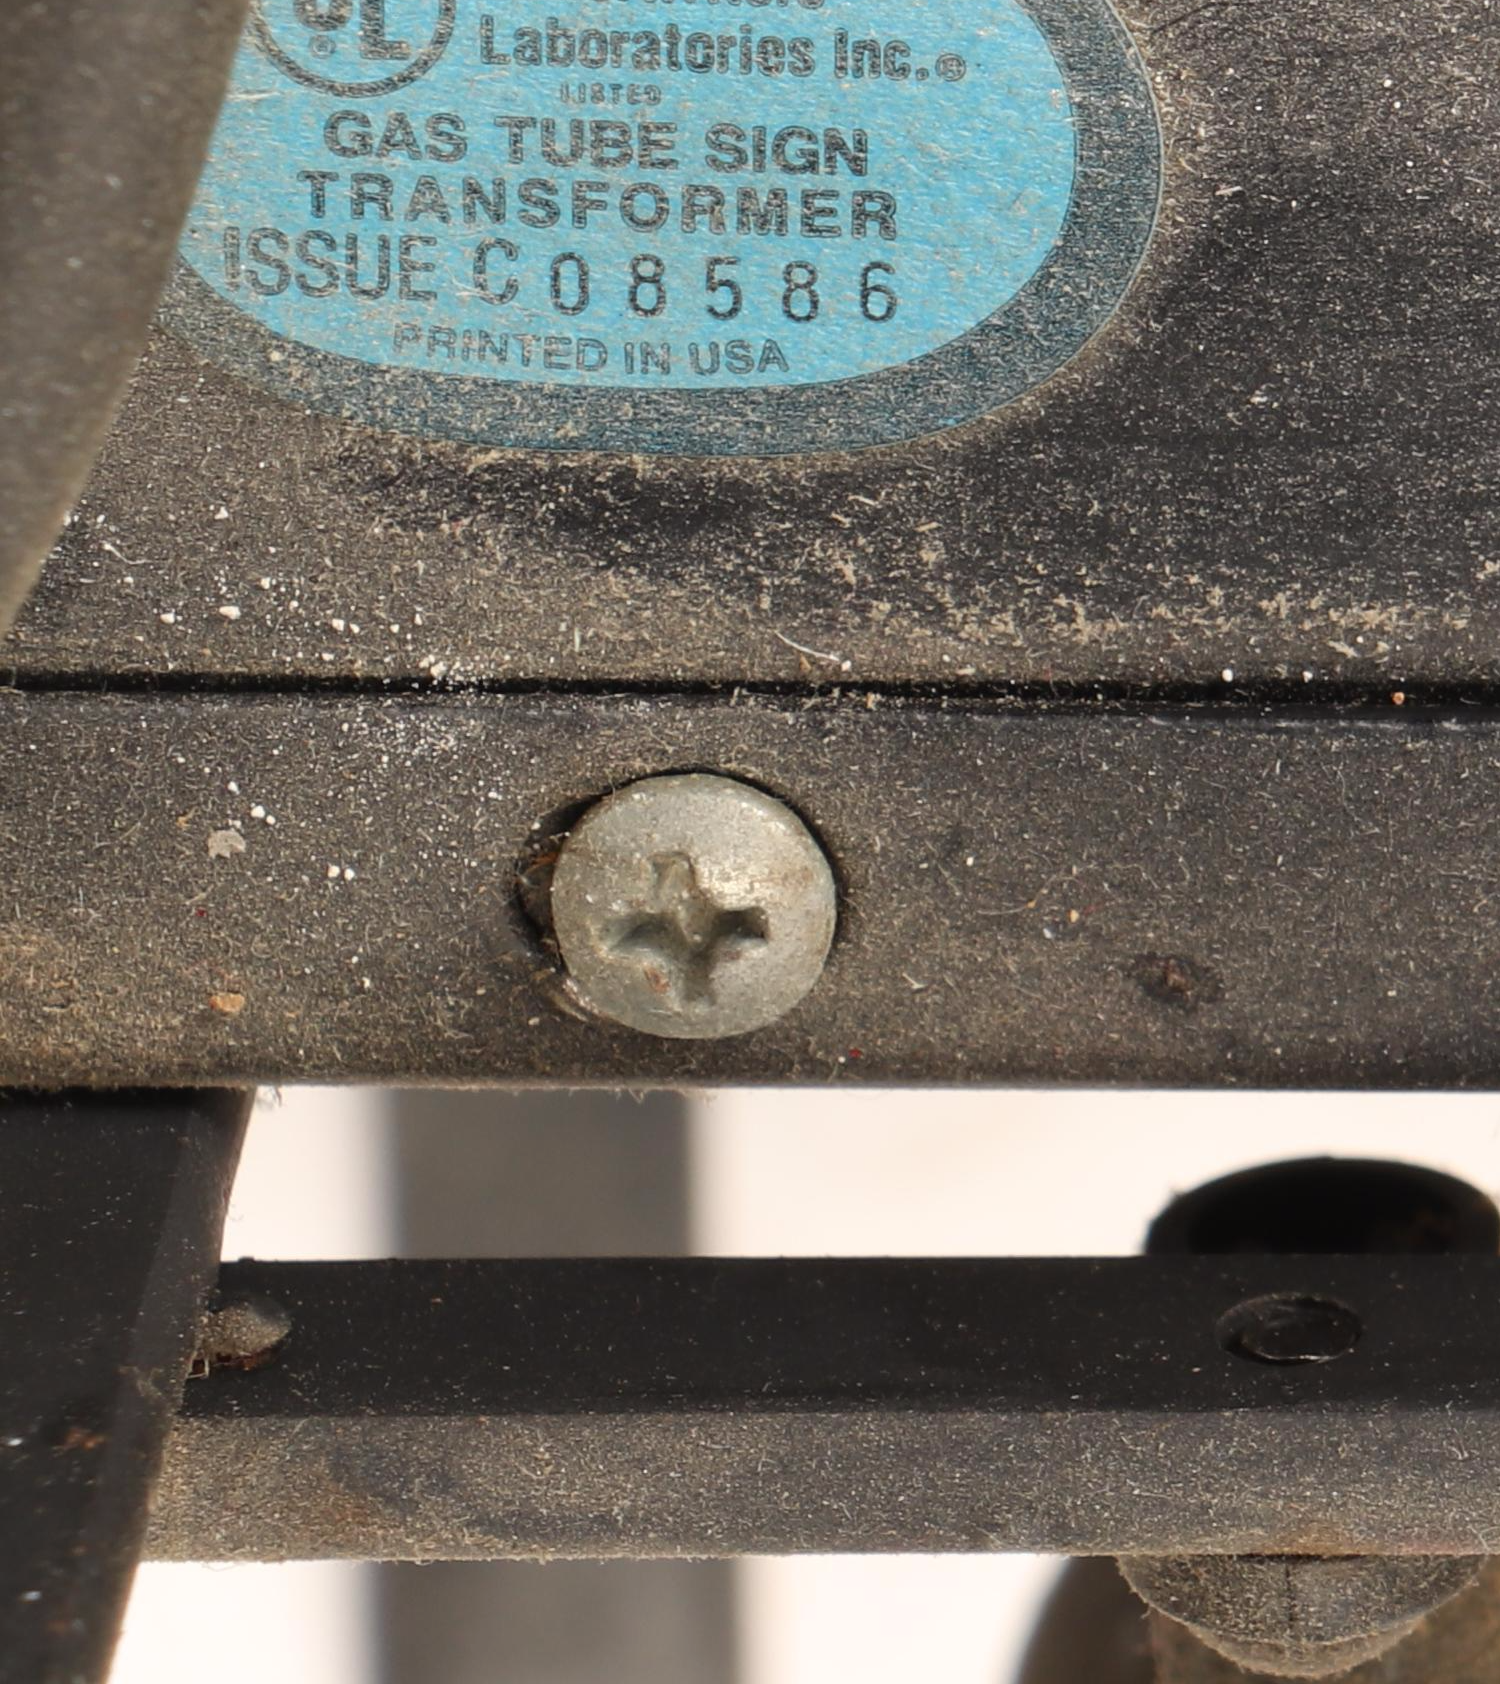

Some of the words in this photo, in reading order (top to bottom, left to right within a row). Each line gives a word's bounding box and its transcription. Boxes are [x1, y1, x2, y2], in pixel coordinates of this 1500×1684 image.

[477, 13, 817, 79] Laboratories
[321, 108, 470, 164] GAS
[493, 114, 680, 171] TUBE
[703, 121, 869, 178] SIGN
[296, 168, 898, 242] TRANSFORMER
[222, 225, 439, 302] ISSUE
[392, 320, 609, 373] PRINTED
[624, 339, 672, 376] IN
[686, 337, 791, 377] USA
